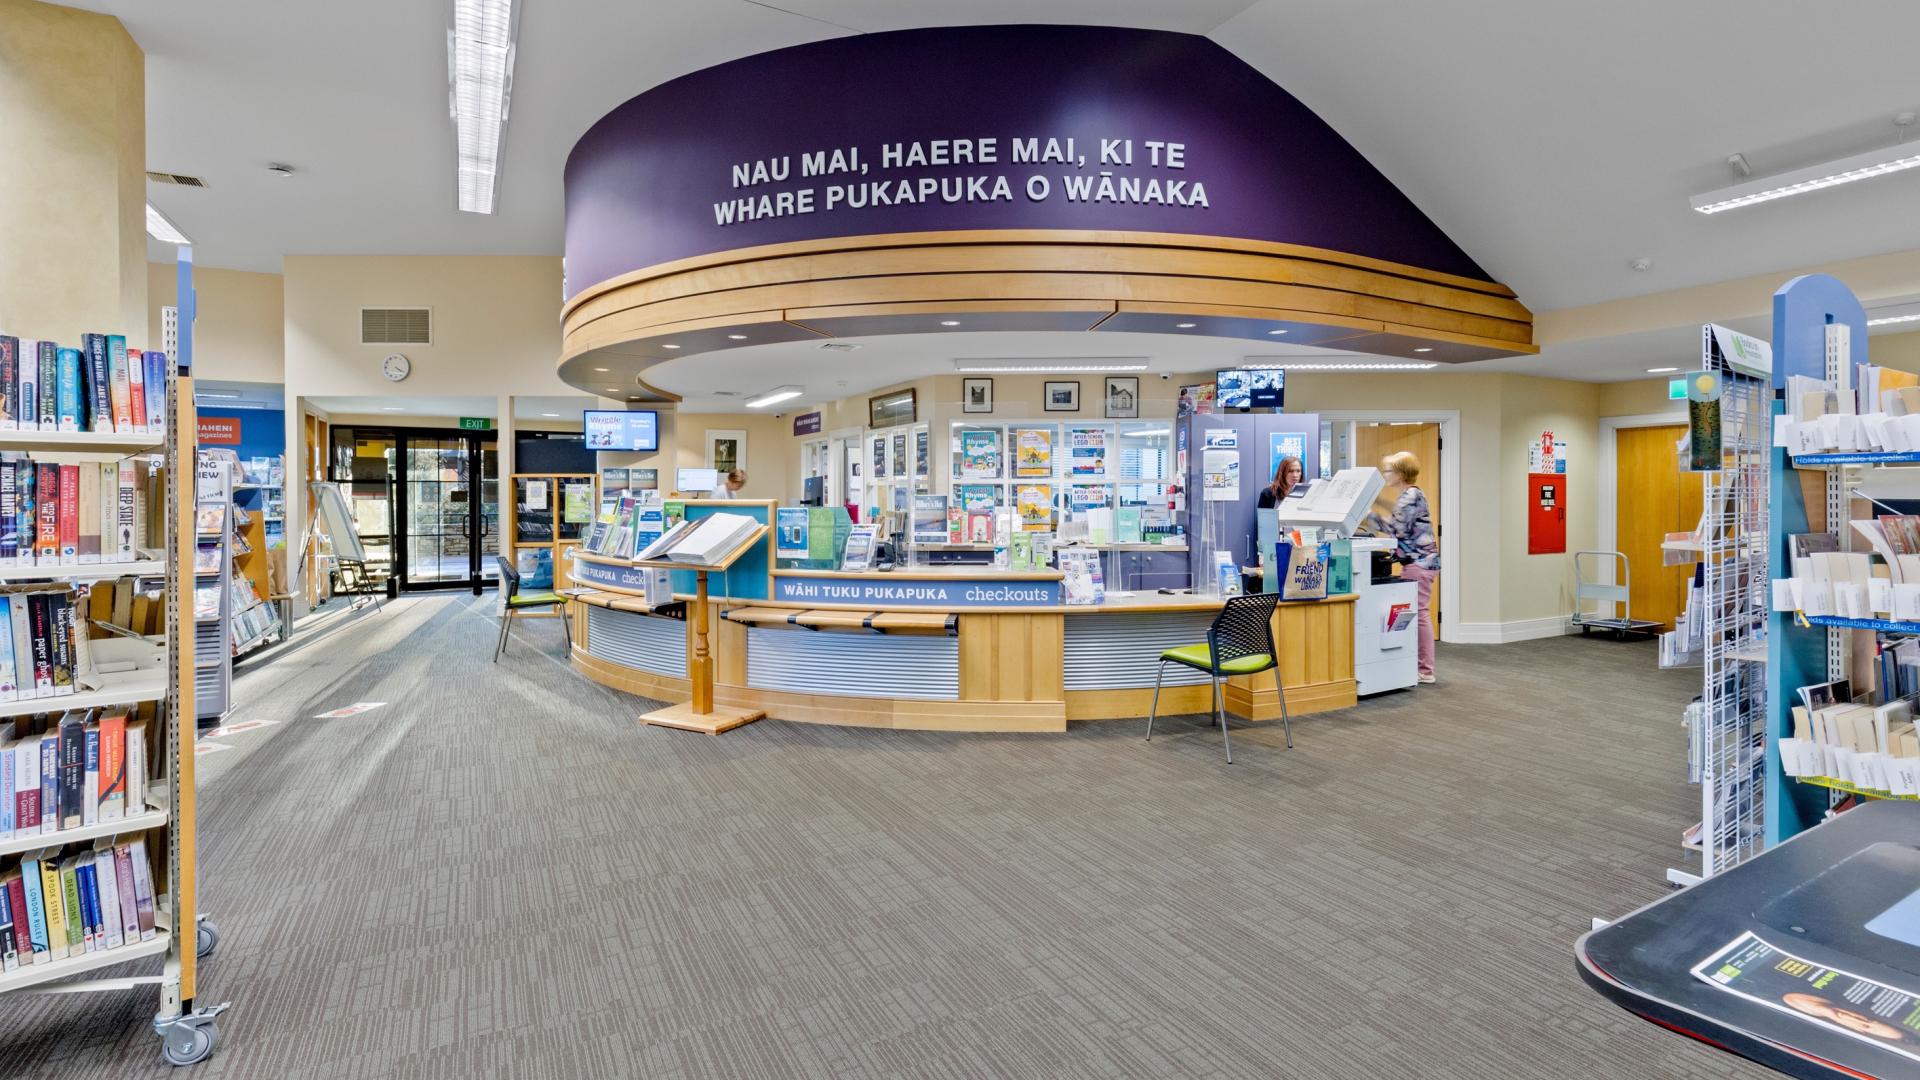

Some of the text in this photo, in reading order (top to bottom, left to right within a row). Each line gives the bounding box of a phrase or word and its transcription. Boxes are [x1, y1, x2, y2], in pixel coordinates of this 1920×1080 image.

[732, 137, 1185, 188] NAU MAI, HAERE MAI, KI TE
[714, 171, 1209, 225] WHARE PUKAPUKA O WĀNAKA
[95, 361, 105, 381] NATURE
[466, 419, 485, 429] EXIT
[198, 431, 233, 440] agazines
[1796, 455, 1820, 463] Holds
[1824, 453, 1864, 463] available
[1881, 453, 1914, 462] collect
[1, 466, 15, 492] MICHAEL
[120, 487, 134, 504] DEEP
[120, 506, 134, 527] STATE
[42, 515, 55, 541] FIRE
[590, 568, 617, 581] PUKAPUKA
[622, 571, 646, 586] check
[1295, 562, 1324, 575] FRIEND
[784, 582, 1049, 602] WĀHI TUKU PUKAPUKA checkouts
[57, 607, 67, 643] black-eyed
[1827, 618, 1868, 627] available
[1872, 620, 1881, 628] to
[1884, 622, 1916, 631] collect
[35, 637, 50, 679] paper ghos
[29, 887, 39, 917] LONDON
[47, 875, 60, 925] SPOOK STREET
[66, 879, 78, 921] DEAD LIONS
